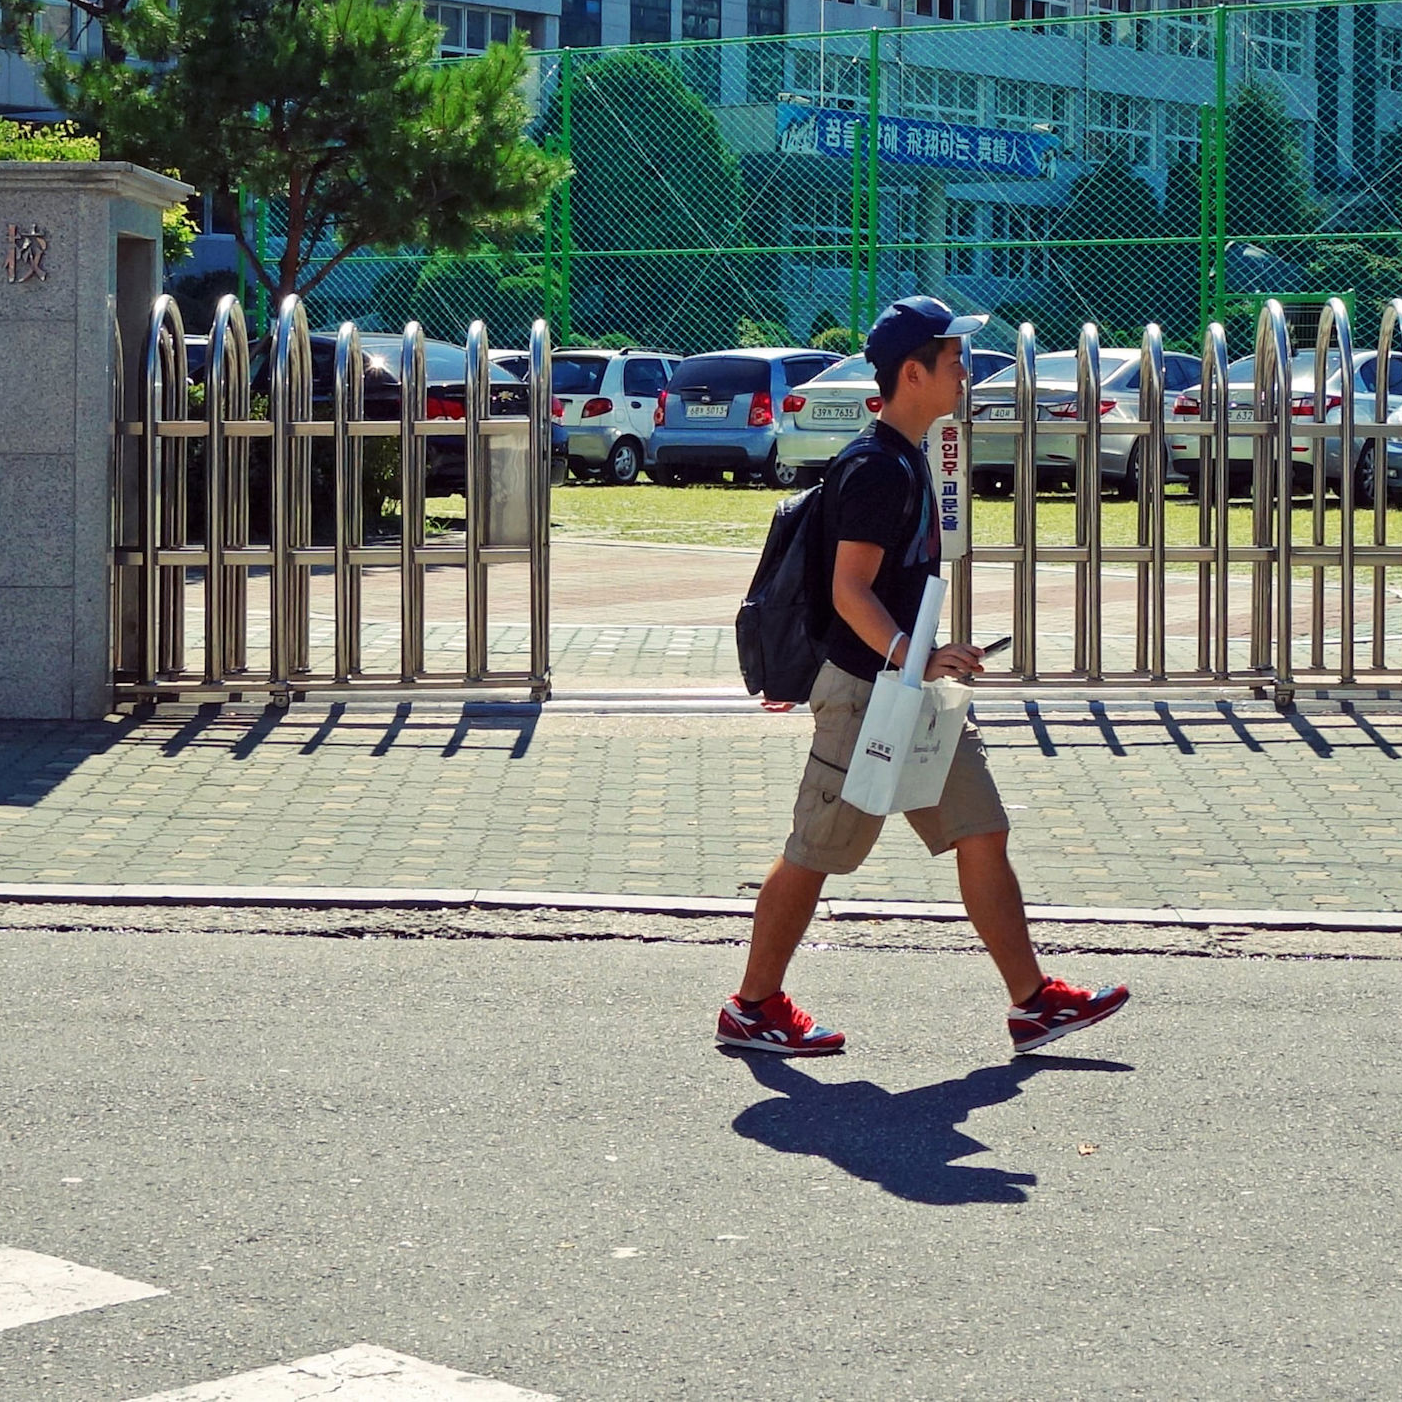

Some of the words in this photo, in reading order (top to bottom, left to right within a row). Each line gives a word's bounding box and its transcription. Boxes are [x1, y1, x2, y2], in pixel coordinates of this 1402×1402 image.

[835, 407, 854, 417] 7635
[941, 427, 958, 476] 출입후
[941, 481, 958, 531] 교문을
